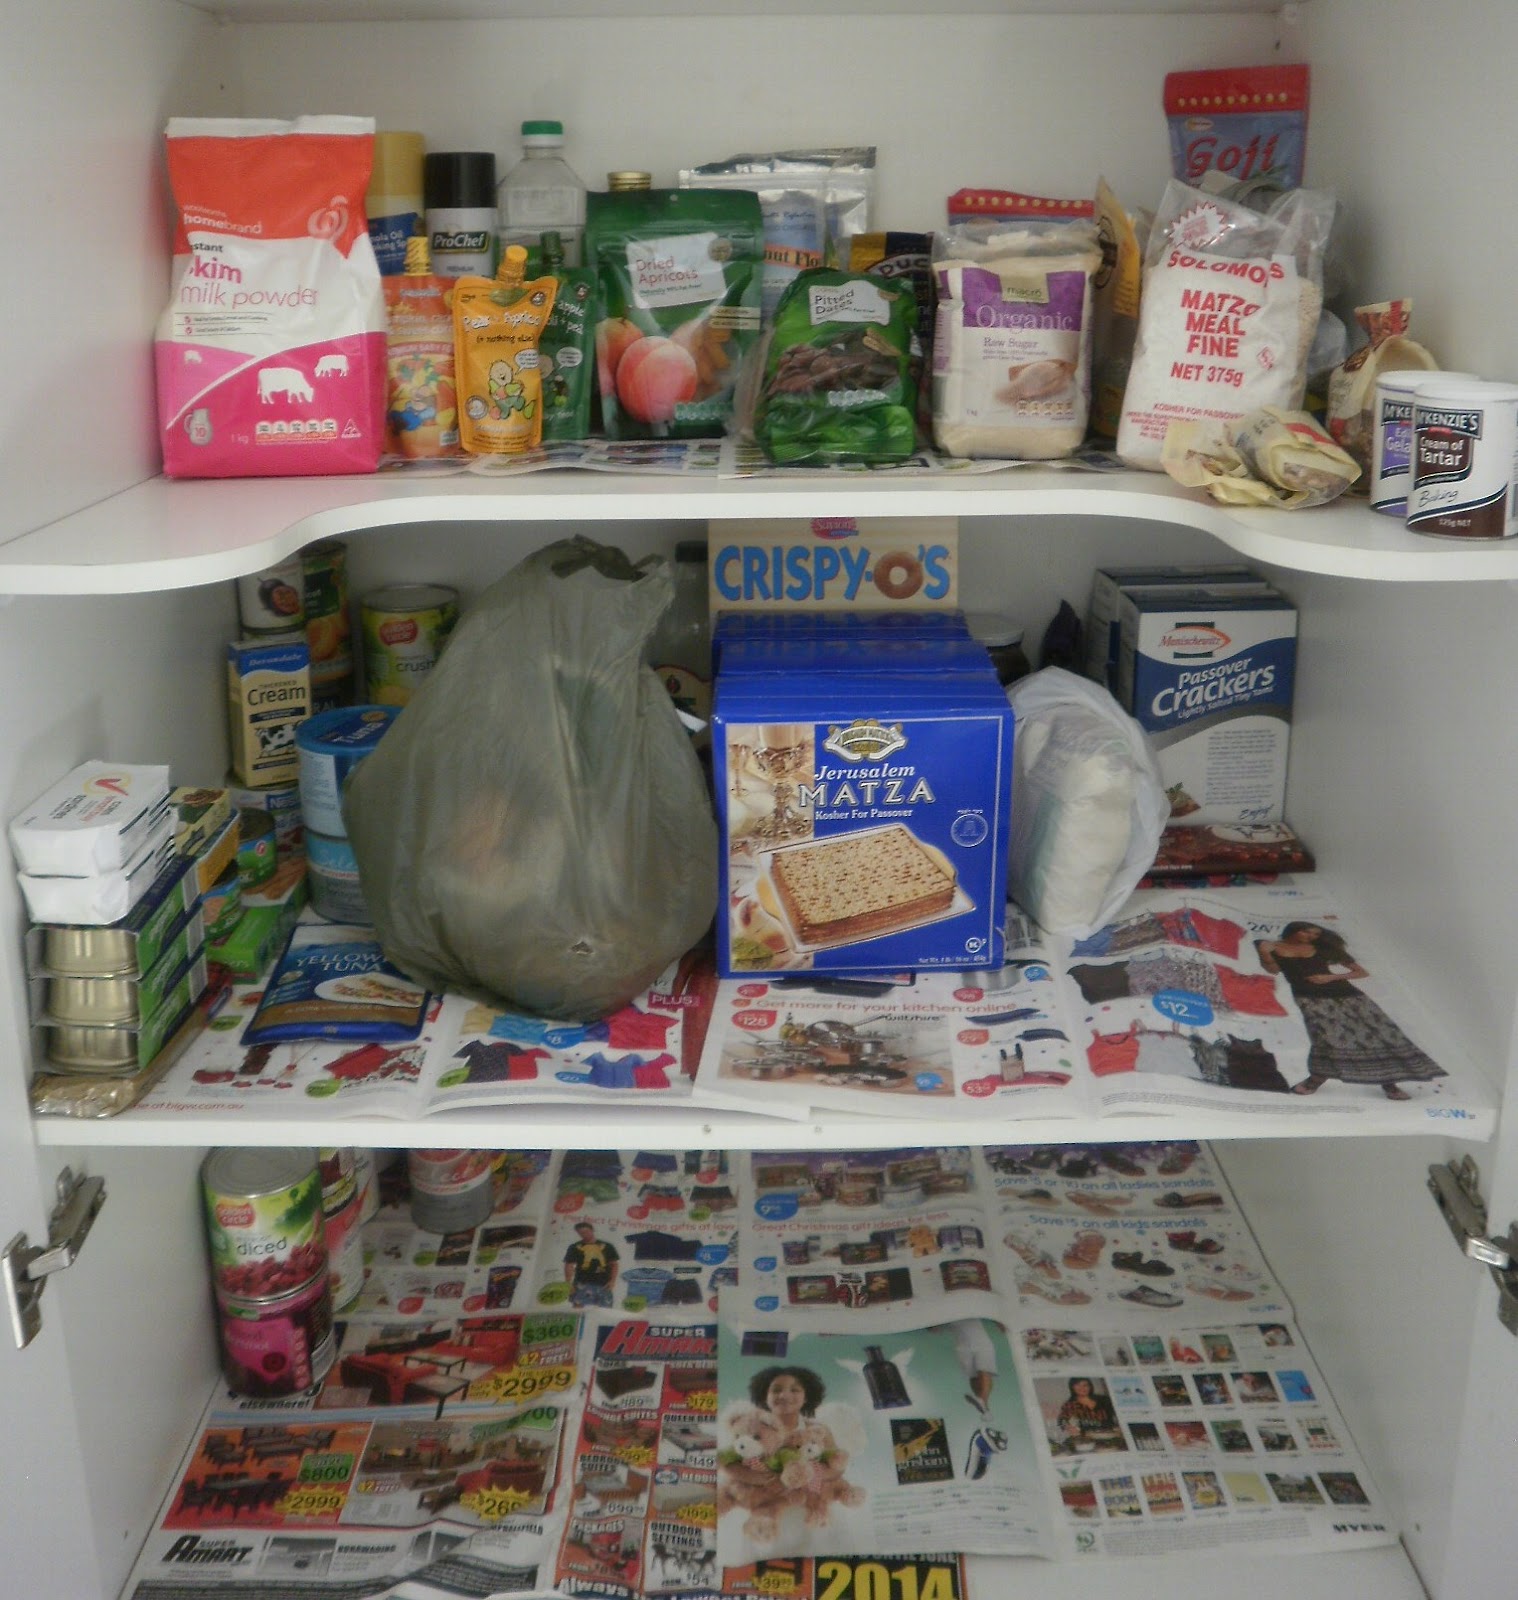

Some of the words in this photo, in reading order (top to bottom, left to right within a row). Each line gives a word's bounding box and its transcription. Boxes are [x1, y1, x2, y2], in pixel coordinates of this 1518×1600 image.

[183, 213, 262, 235] homebrand
[433, 232, 486, 249] ProChef
[636, 256, 675, 271] Dried
[1166, 250, 1285, 286] SOLOMOS
[639, 269, 699, 287] Apricots
[181, 282, 226, 306] milk
[815, 289, 854, 305] Pitted
[1006, 286, 1043, 297] macro
[815, 299, 853, 315] Dates
[1180, 288, 1262, 317] MATZO
[975, 304, 1074, 334] Organic
[1185, 312, 1246, 336] MEAL
[984, 336, 1006, 349] Raw
[1007, 336, 1039, 350] Sugar
[1186, 334, 1240, 359] FINE
[1170, 361, 1204, 382] NET
[1206, 366, 1245, 388] 375g
[1419, 437, 1449, 450] Cream
[1450, 439, 1464, 451] of
[1420, 447, 1463, 466] Tartar
[1178, 657, 1252, 690] Passover
[247, 684, 306, 707] Cream
[1151, 664, 1275, 717] Crackers
[814, 762, 916, 781] Jerusalem
[799, 776, 936, 808] MATZA
[815, 809, 849, 820] Kosher
[851, 809, 868, 819] For
[870, 807, 913, 819] Passover
[296, 953, 387, 968] YELLOW
[322, 962, 382, 972] TUNA
[652, 994, 693, 1006] PLUS
[756, 1000, 786, 1009] Get
[789, 1001, 834, 1010] more
[836, 1001, 859, 1011] for
[863, 1003, 898, 1013] your
[902, 1003, 962, 1013] kitchen
[966, 1003, 1018, 1013] online
[1081, 1181, 1098, 1191] on
[1102, 1180, 1118, 1191] all
[1119, 1180, 1160, 1191] ladies
[1162, 1177, 1216, 1189] sandals
[752, 1222, 787, 1232] Great
[788, 1222, 849, 1232] Christmas
[851, 1220, 872, 1232] gift
[873, 1218, 906, 1230] ideas
[1029, 1214, 1064, 1226] Save
[1081, 1219, 1099, 1228] on
[1102, 1217, 1119, 1228] all
[1151, 1217, 1208, 1228] sandals
[236, 1237, 287, 1256] diced
[649, 1327, 706, 1337] SUPER
[493, 1370, 572, 1398] $2999
[650, 1522, 703, 1537] OUTDOOR
[1332, 1523, 1386, 1533] MYER
[199, 1539, 236, 1548] SUPER
[651, 1532, 703, 1548] SETTINGS
[817, 1560, 958, 1600] 2014
